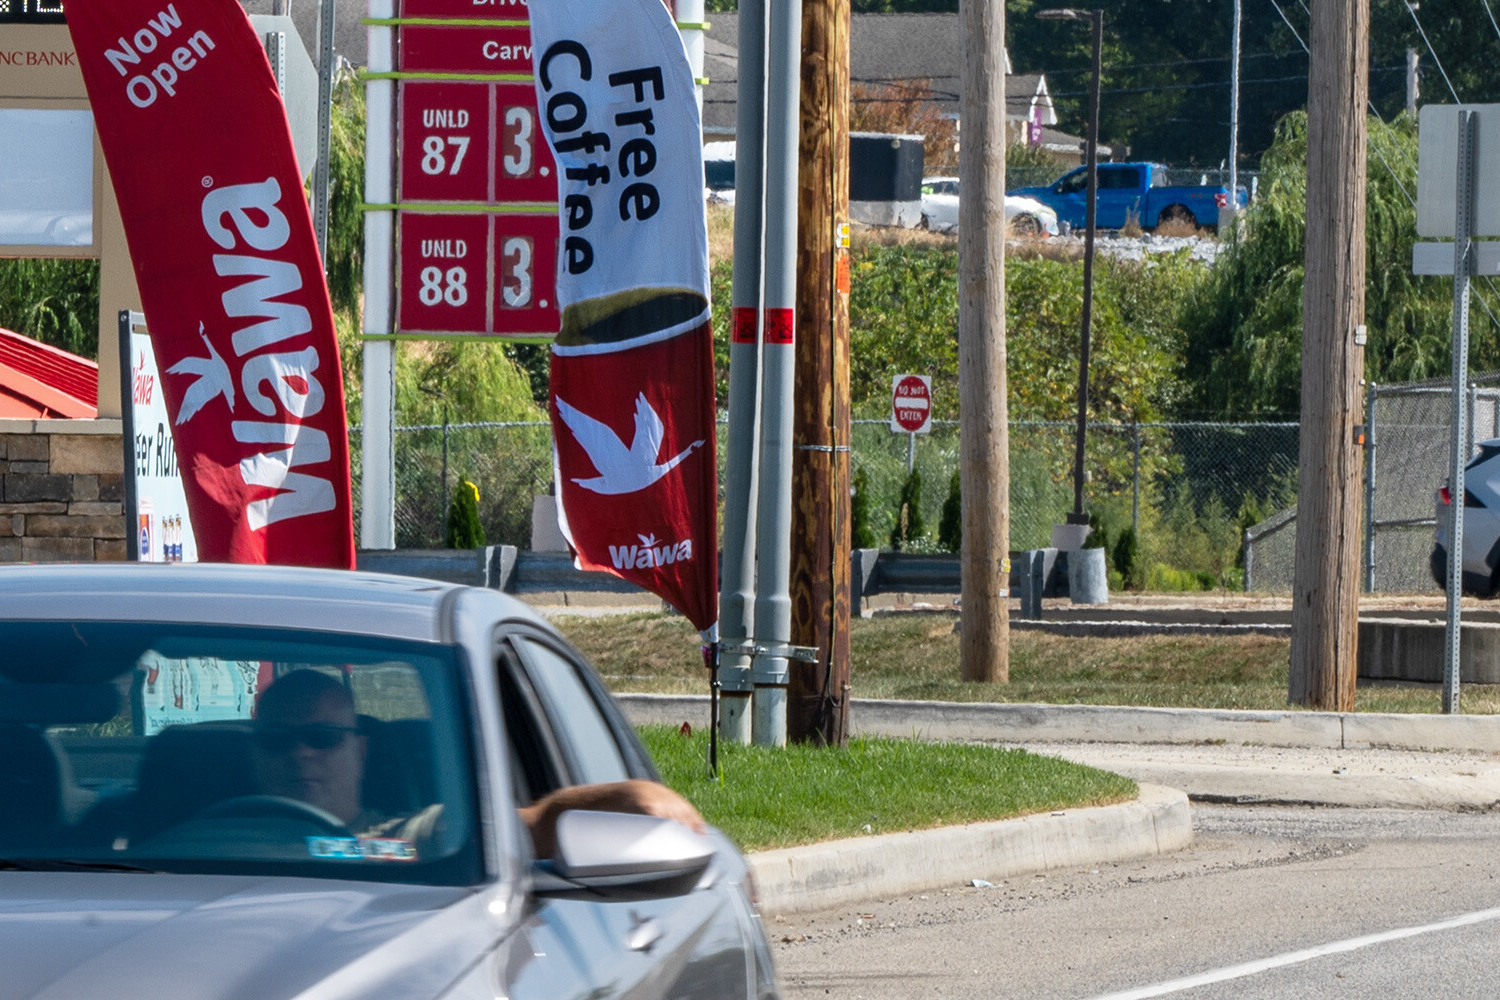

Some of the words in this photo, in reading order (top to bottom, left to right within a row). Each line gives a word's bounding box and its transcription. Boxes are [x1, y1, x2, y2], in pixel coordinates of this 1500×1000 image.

[103, 2, 183, 77] Now
[126, 28, 216, 109] Open
[422, 108, 469, 128] UNLD
[421, 135, 471, 176] 87
[608, 66, 665, 222] Free
[421, 239, 467, 258] UNLD
[418, 265, 468, 306] 88
[201, 176, 338, 532] Wawa
[899, 410, 922, 421] ENTER
[136, 434, 154, 477] eer
[608, 538, 692, 570] Wawa
